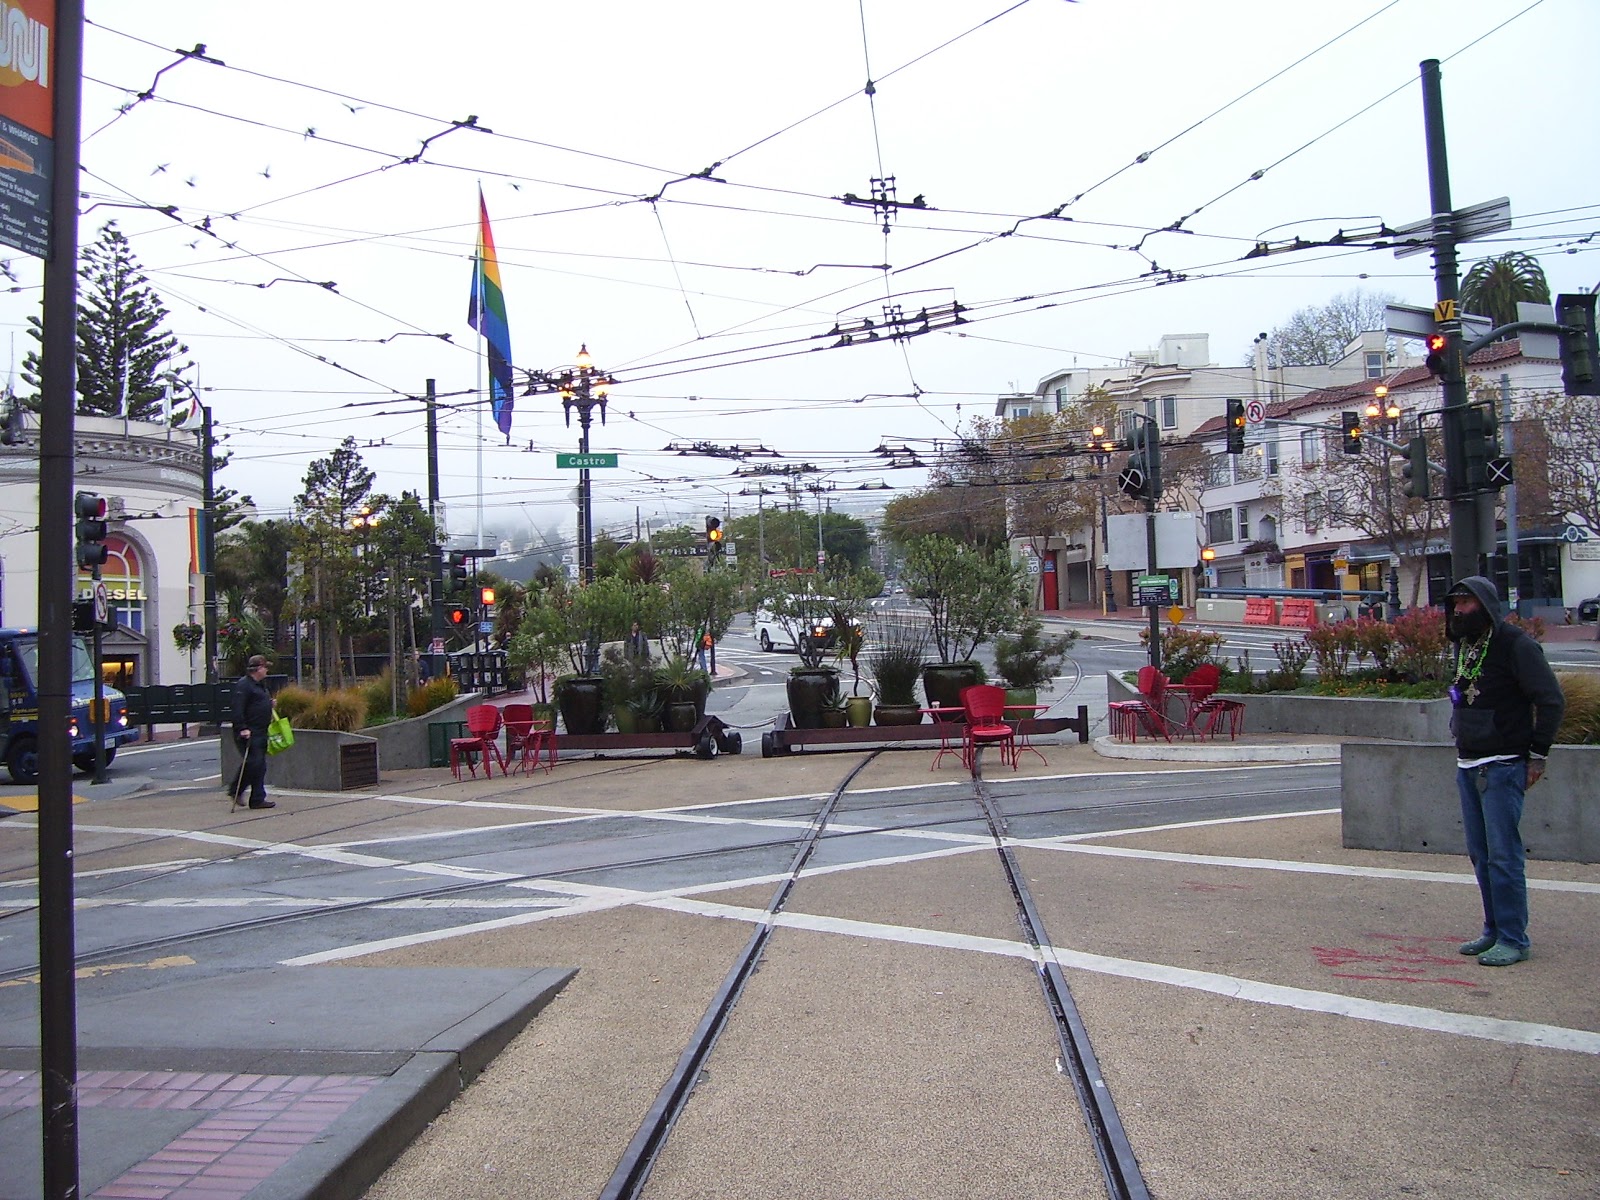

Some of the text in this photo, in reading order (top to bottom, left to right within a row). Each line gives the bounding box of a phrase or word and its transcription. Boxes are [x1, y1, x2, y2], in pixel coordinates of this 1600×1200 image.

[1437, 301, 1451, 320] V
[568, 457, 606, 466] Castro
[1027, 565, 1039, 573] 30
[82, 588, 148, 601] DESEL
